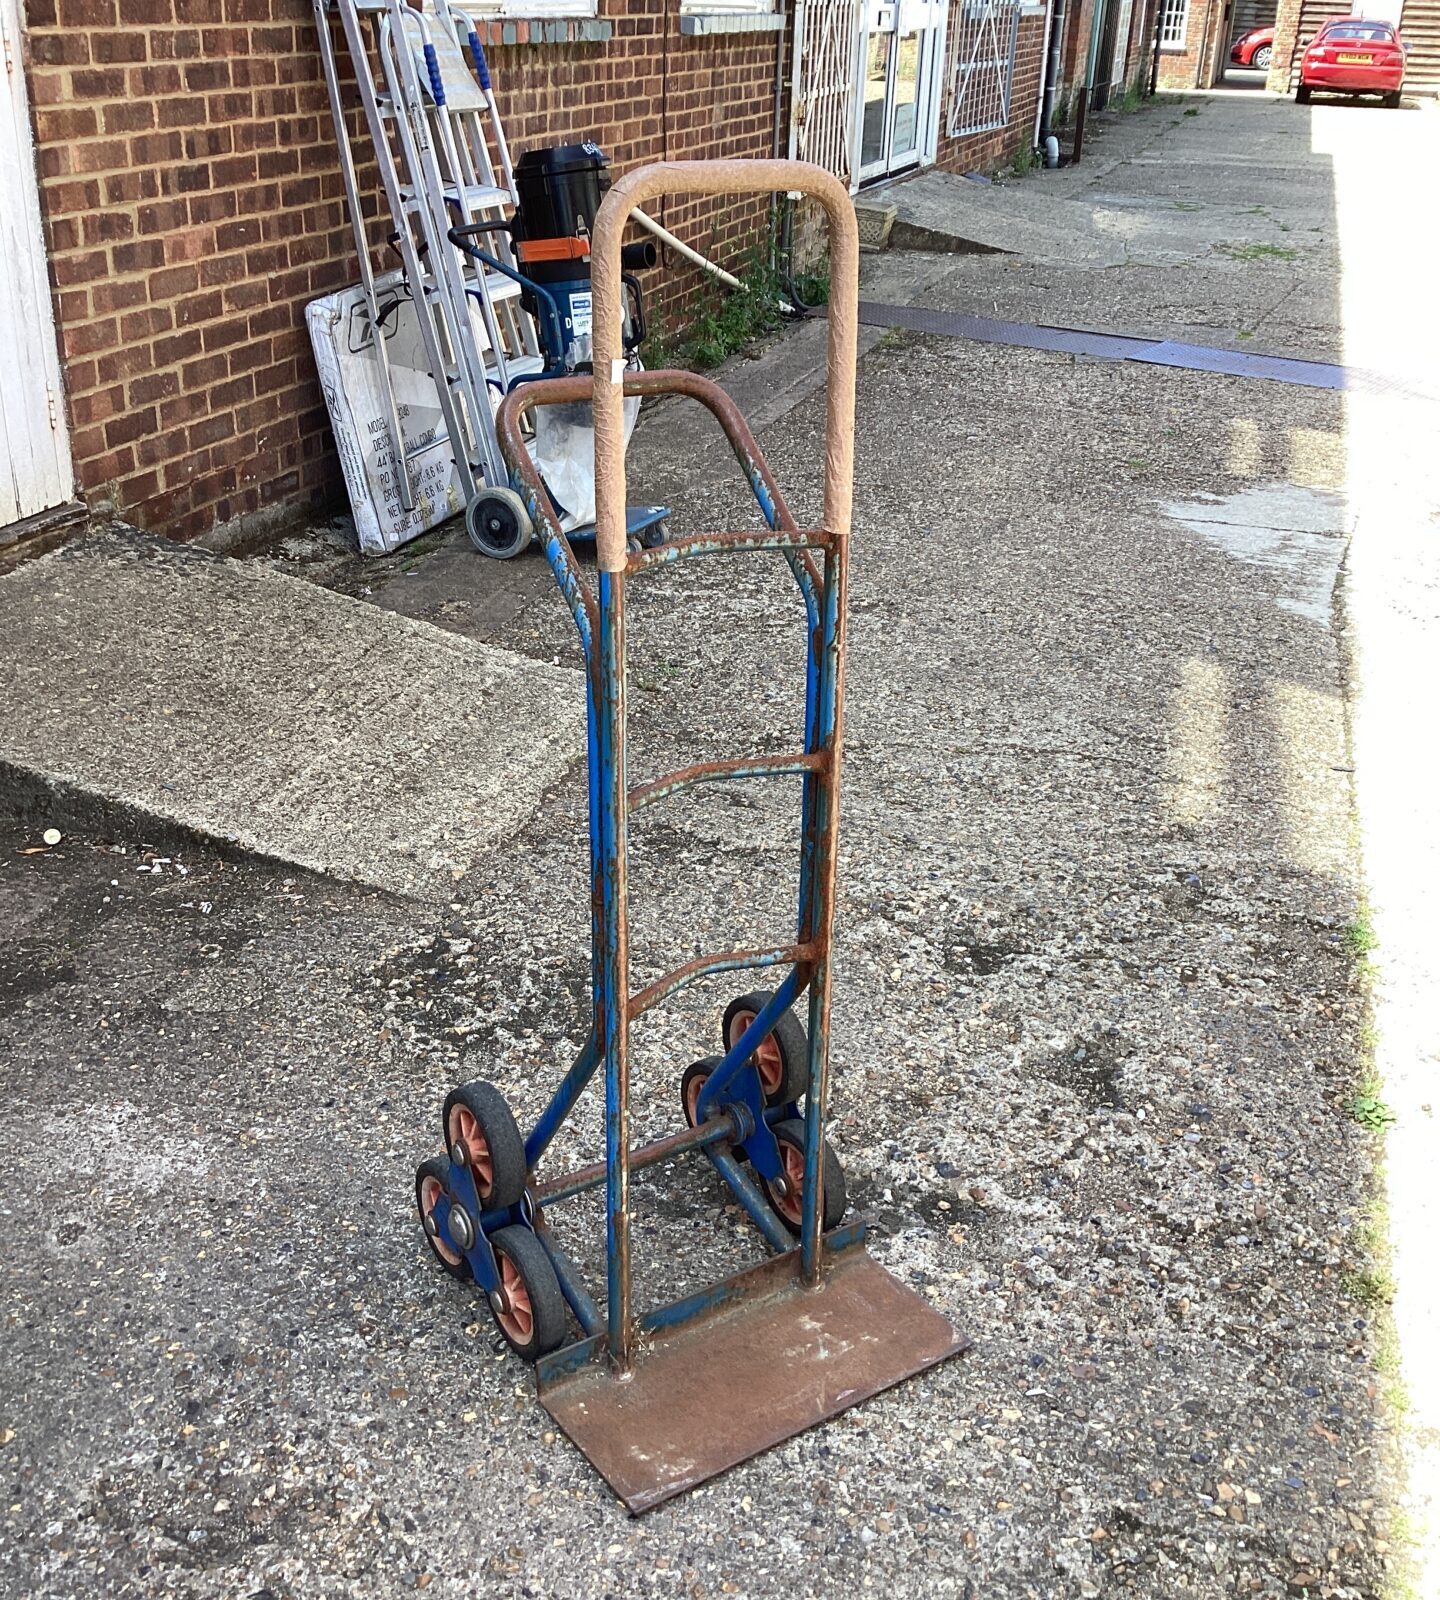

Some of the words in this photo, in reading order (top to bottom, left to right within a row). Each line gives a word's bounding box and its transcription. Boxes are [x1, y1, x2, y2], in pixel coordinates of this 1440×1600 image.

[435, 460, 445, 474] KG
[379, 471, 390, 486] PO
[387, 502, 401, 519] NET
[435, 480, 445, 493] KG
